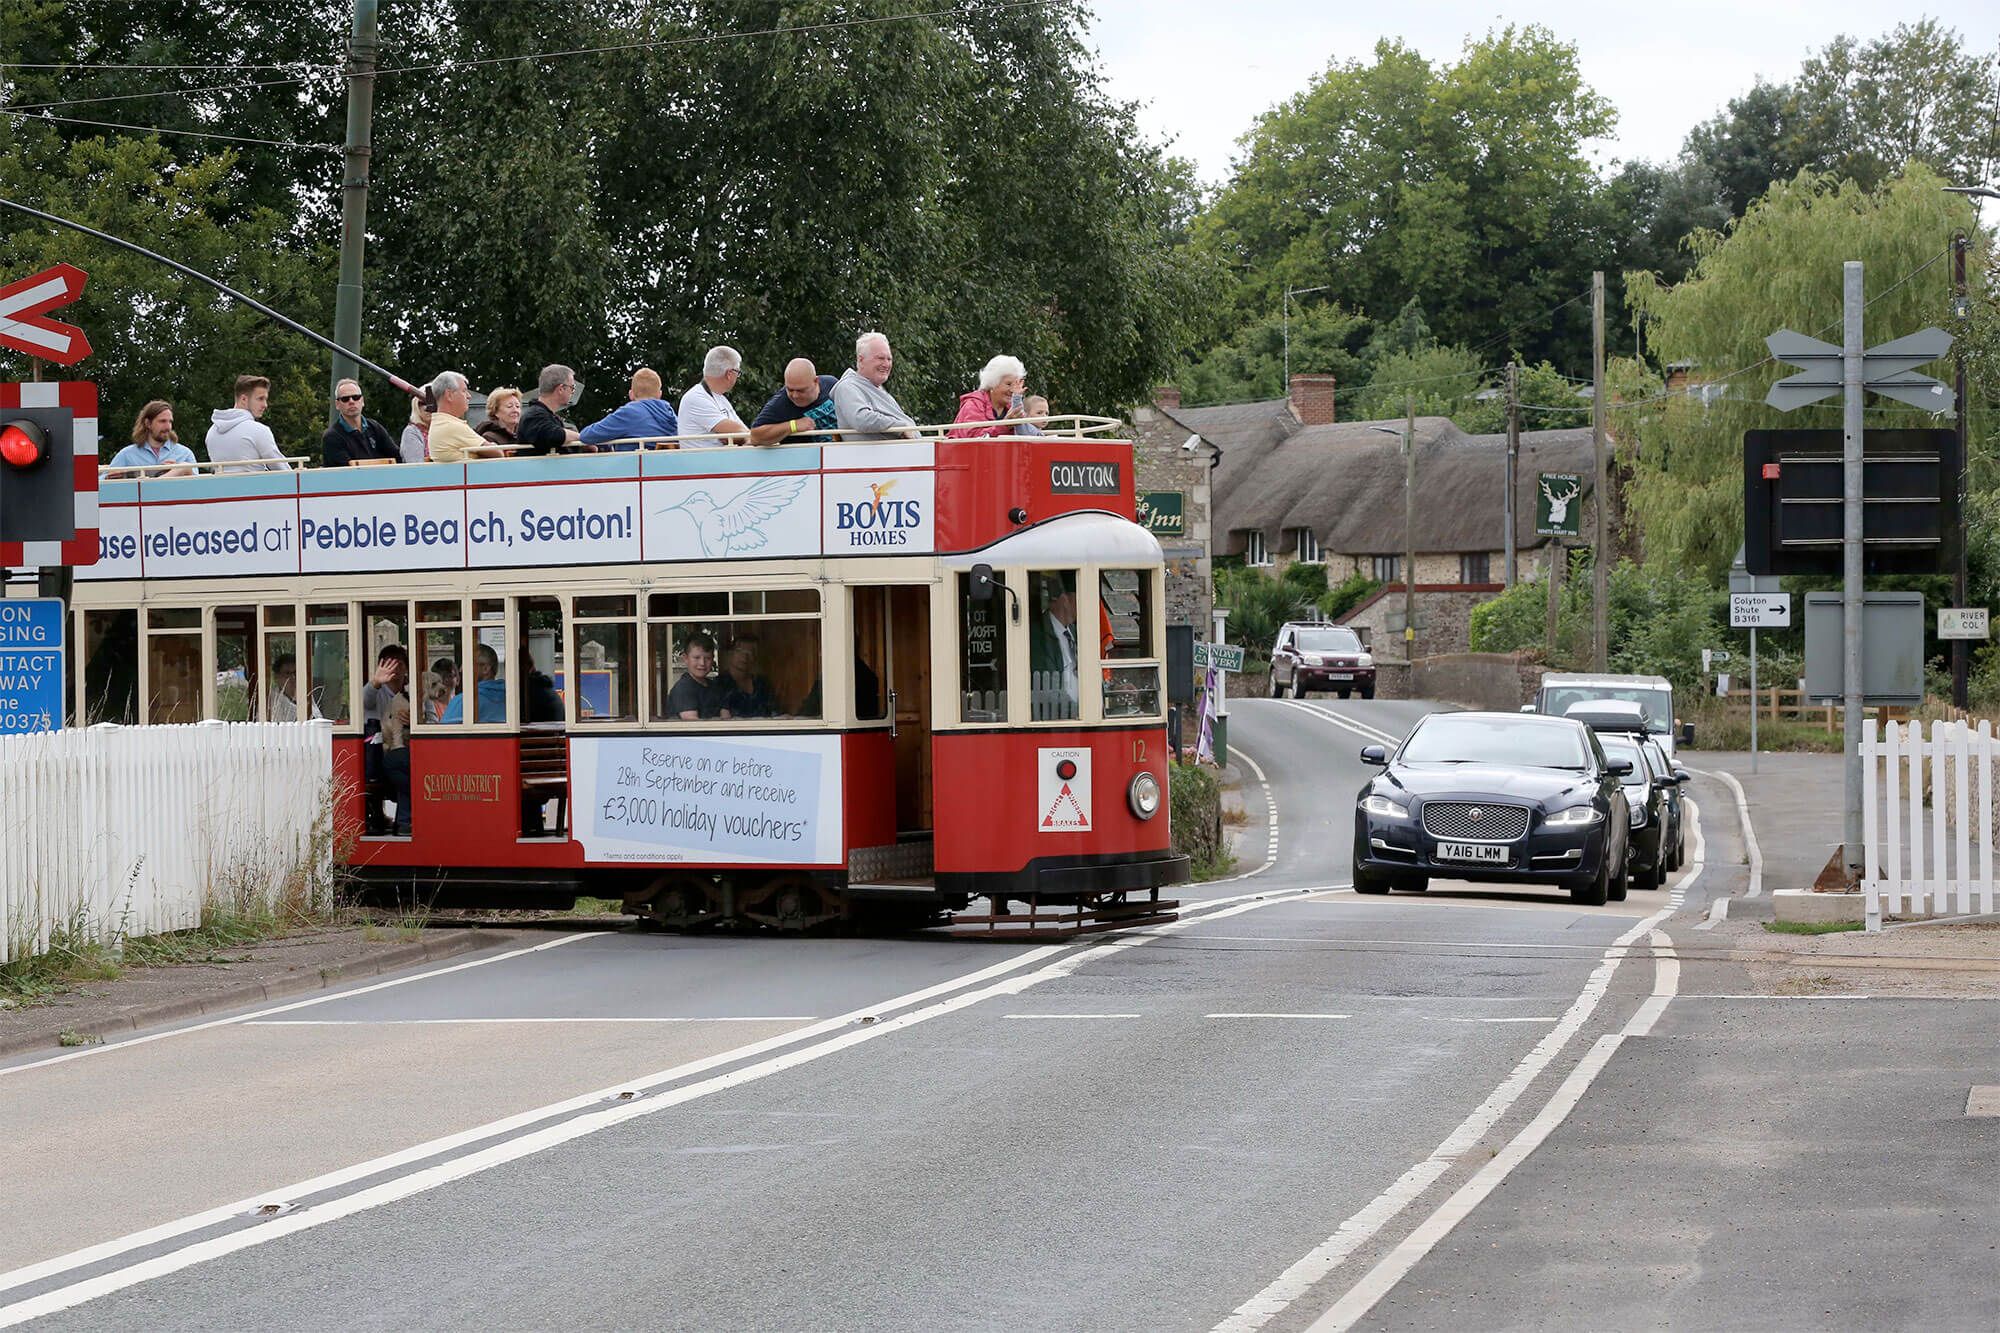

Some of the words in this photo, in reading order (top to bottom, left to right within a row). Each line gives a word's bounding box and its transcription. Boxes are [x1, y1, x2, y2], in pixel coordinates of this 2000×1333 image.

[1051, 465, 1115, 487] COLYTON
[836, 500, 921, 529] BOVIS
[1144, 507, 1182, 529] Inn
[144, 522, 258, 557] released
[263, 520, 292, 551] at
[301, 515, 397, 550] Pebble
[520, 505, 633, 543] Seaton!
[850, 530, 907, 546] HOMES
[1734, 597, 1767, 605] Colyton
[1734, 606, 1760, 614] Shute
[0, 607, 31, 622] ON
[1960, 611, 1985, 620] RIVER
[1962, 621, 1985, 629] COL
[1194, 655, 1239, 668] CAVERY
[0, 714, 52, 729] 0375
[1133, 739, 1147, 763] 12
[642, 747, 693, 771] Reserve
[696, 757, 711, 772] on
[715, 758, 729, 773] or
[733, 757, 774, 778] before
[424, 774, 455, 800] SEATON
[463, 774, 502, 801] DISTRICT
[616, 766, 641, 786] 28th
[645, 769, 718, 797] September
[721, 780, 744, 800] and
[748, 784, 797, 804] receive
[603, 796, 657, 827] £3,000
[662, 800, 718, 842] holiday
[1446, 845, 1473, 858] YA16
[1476, 847, 1501, 859] LMM
